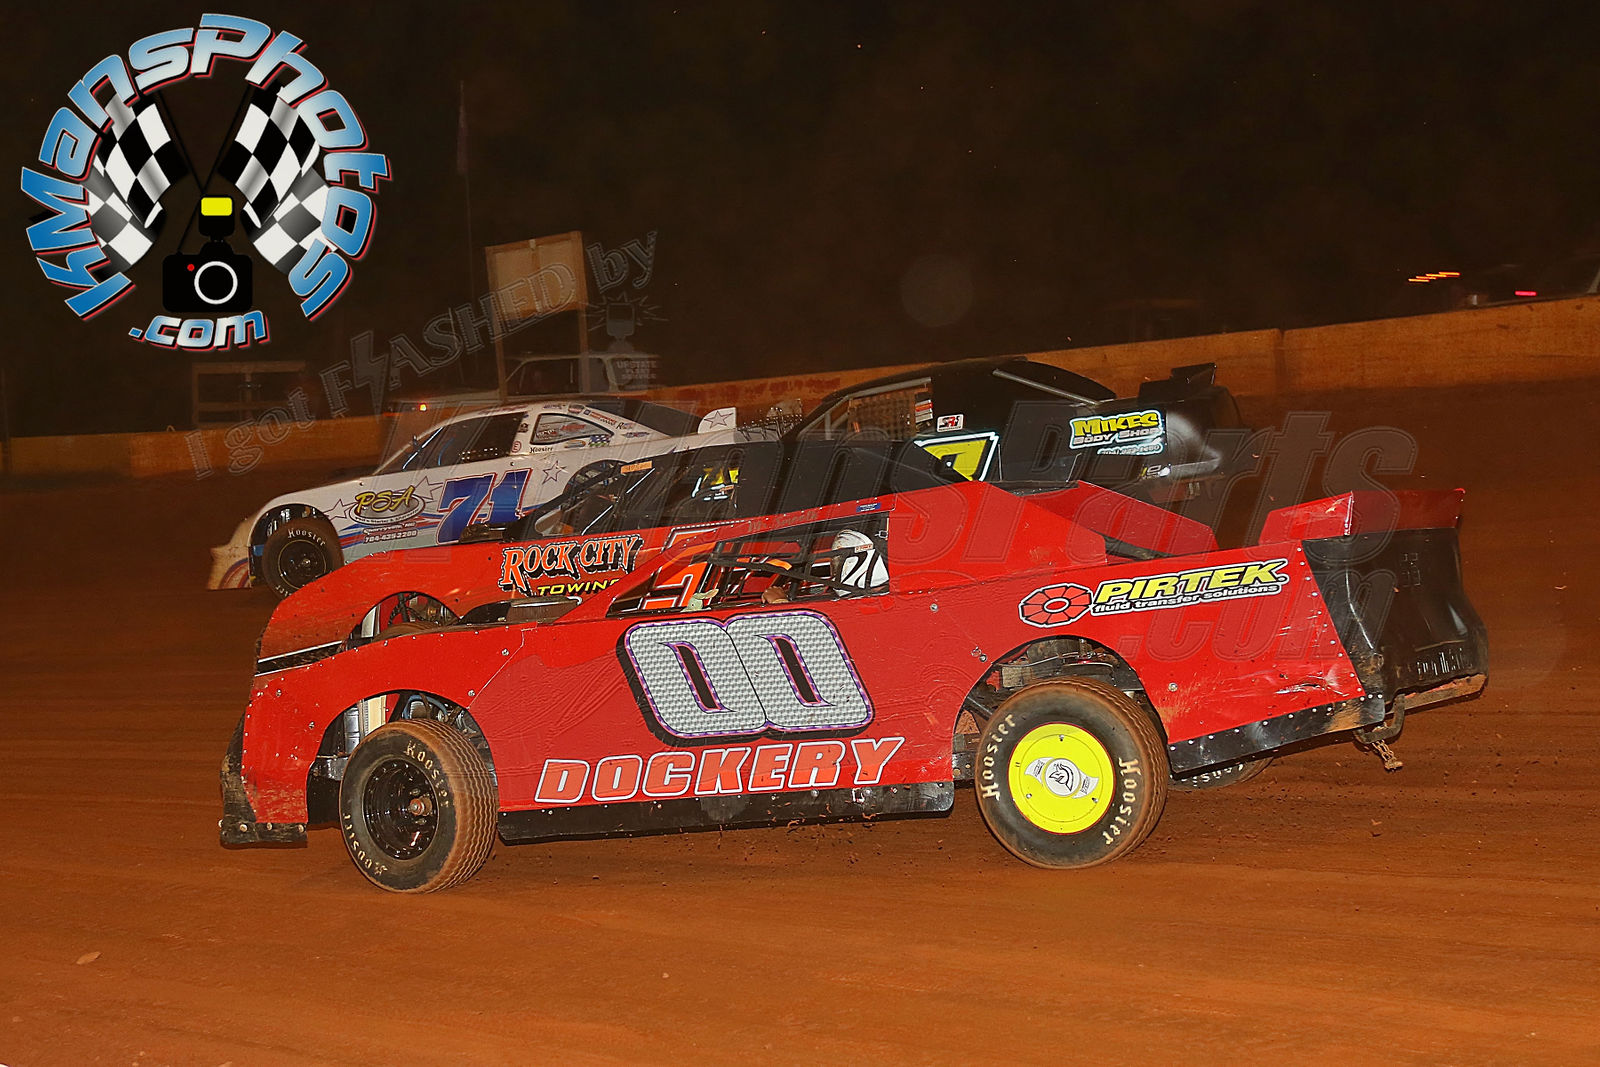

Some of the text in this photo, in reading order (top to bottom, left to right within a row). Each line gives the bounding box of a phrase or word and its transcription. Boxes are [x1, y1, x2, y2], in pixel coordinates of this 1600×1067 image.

[1072, 426, 1162, 446] BODY SHOP
[1073, 412, 1160, 437] MIKES
[355, 485, 416, 515] PSA
[437, 467, 533, 545] 71
[287, 527, 326, 547] Hoosier
[499, 534, 643, 593] ROCK CITY
[1095, 560, 1284, 604] PIRTEK
[1093, 582, 1280, 614] fluid transfer solutions
[622, 609, 875, 742] 00
[534, 737, 905, 804] DOCKERY
[980, 713, 1014, 802] Hoosier
[1102, 757, 1142, 846] Hoosier
